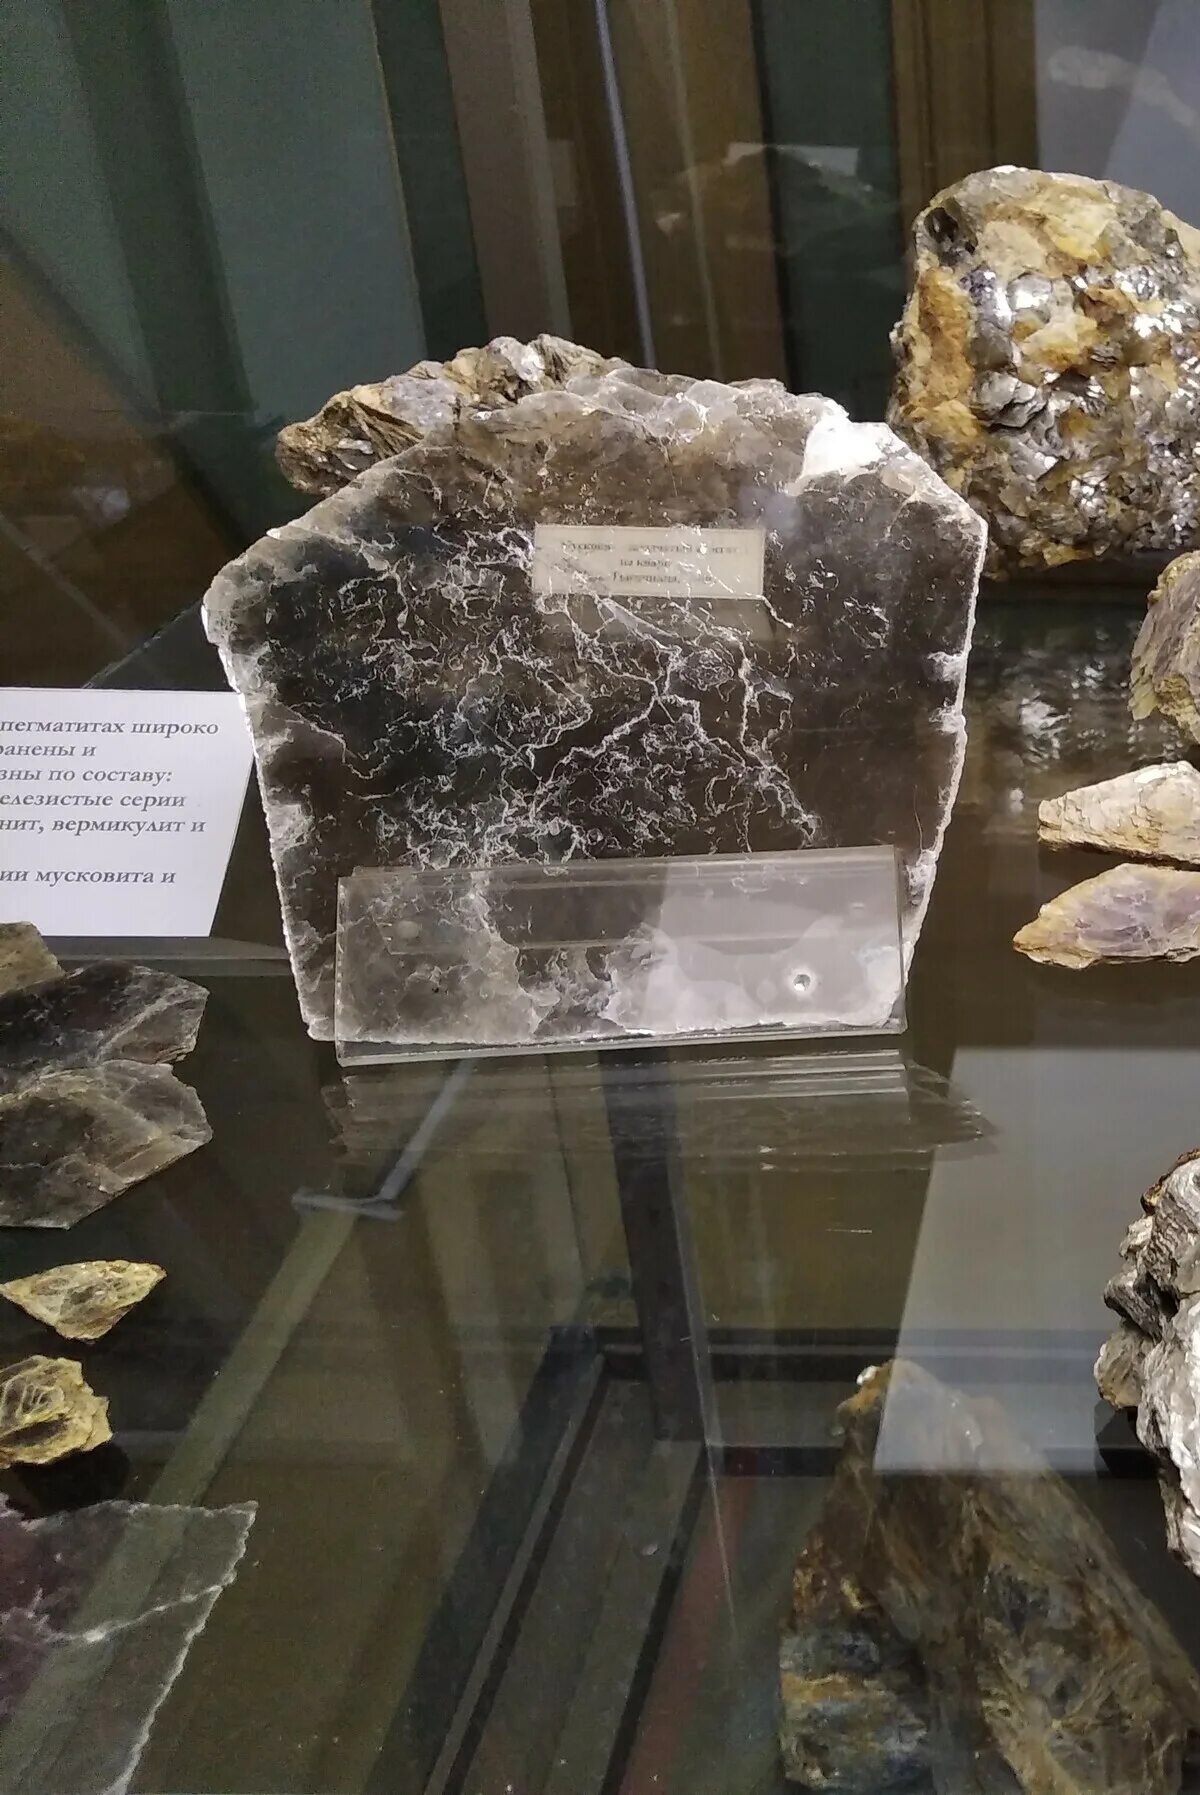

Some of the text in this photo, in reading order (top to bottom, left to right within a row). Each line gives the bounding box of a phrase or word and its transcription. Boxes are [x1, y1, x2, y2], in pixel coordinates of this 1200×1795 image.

[0, 720, 219, 738] пегматитах широко
[81, 746, 96, 757] и
[48, 771, 76, 781] по
[82, 771, 173, 786] составу:
[119, 795, 187, 811] серии
[52, 820, 185, 836] вермикулит
[191, 822, 206, 832] и
[36, 870, 154, 887] мусковита
[160, 872, 176, 884] и
